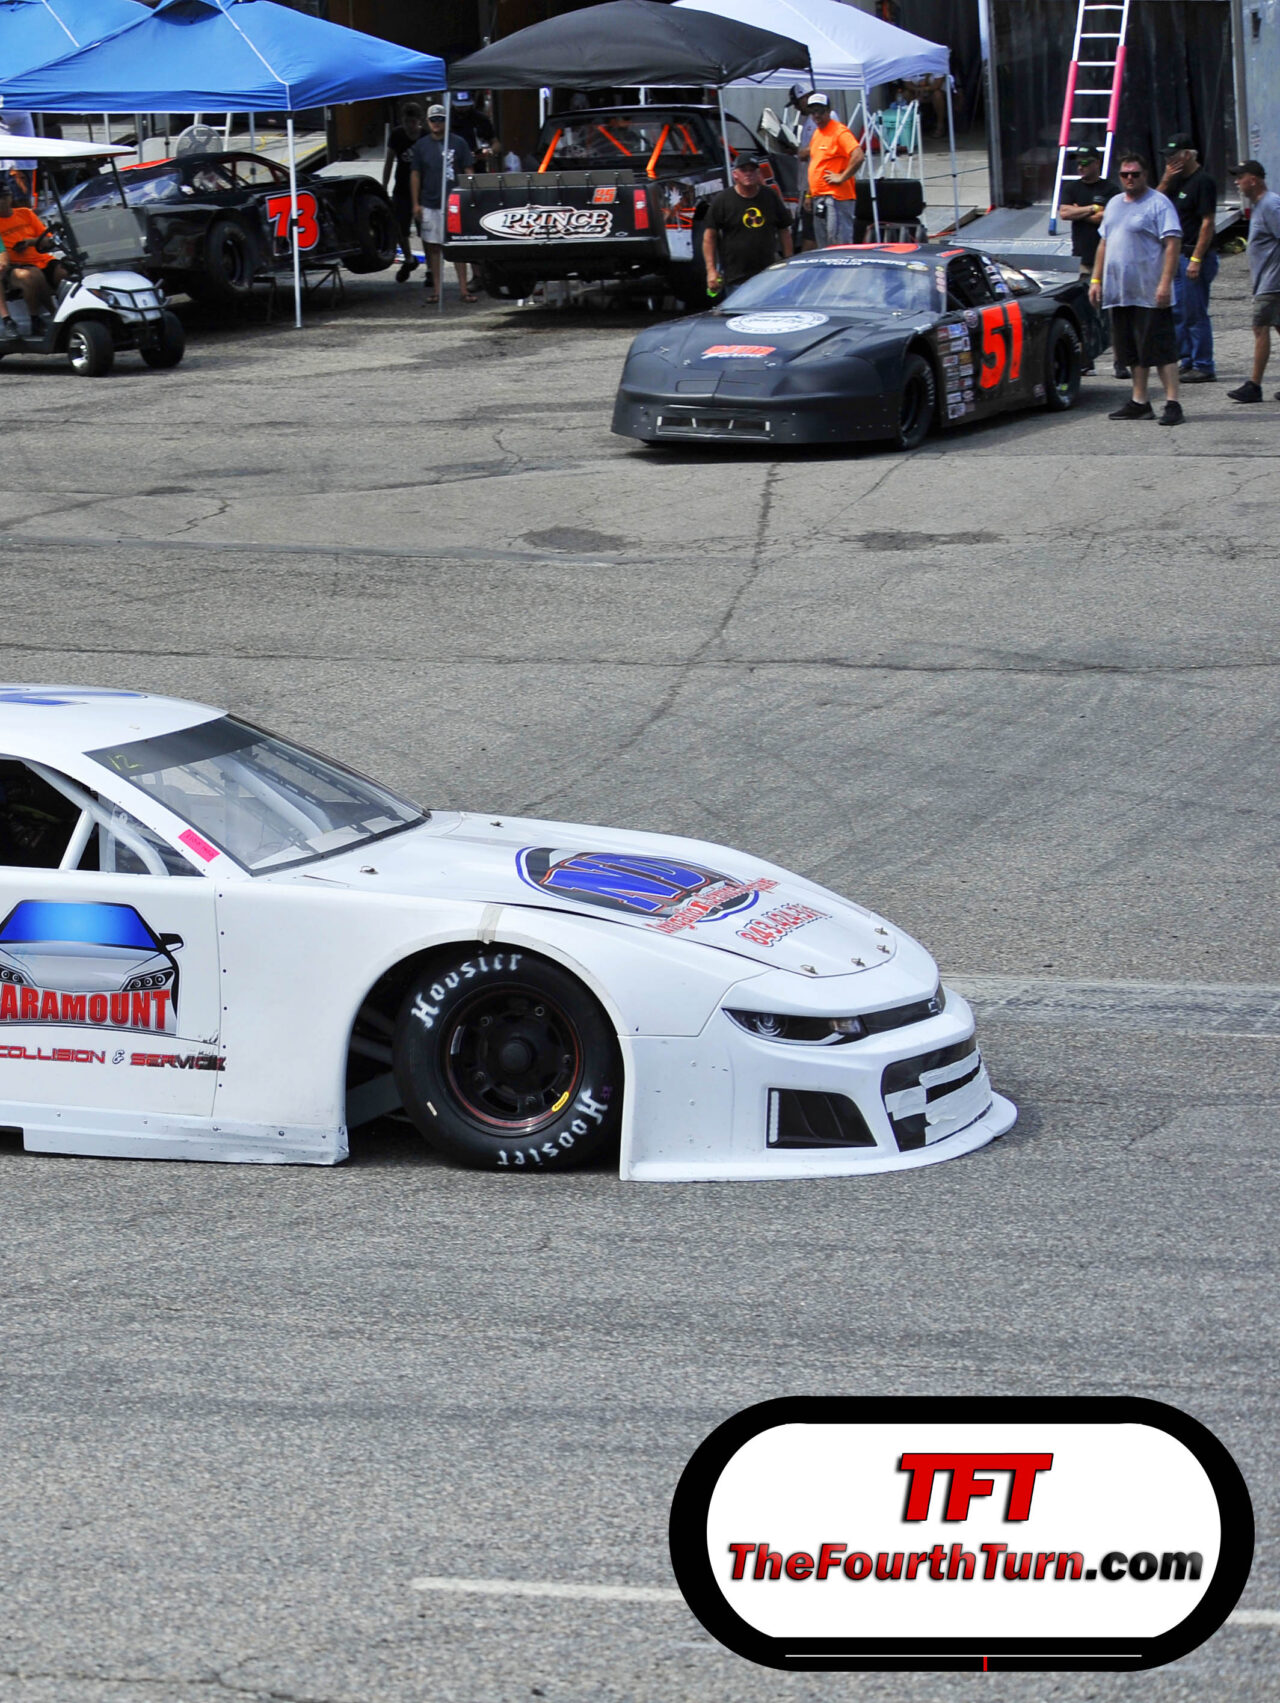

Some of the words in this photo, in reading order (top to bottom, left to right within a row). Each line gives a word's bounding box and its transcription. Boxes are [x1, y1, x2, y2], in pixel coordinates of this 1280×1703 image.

[265, 191, 320, 256] 73
[502, 211, 609, 228] PRINCE
[979, 301, 1024, 390] 51
[411, 950, 523, 1029] Hoosier
[496, 1088, 609, 1166] Hoosier
